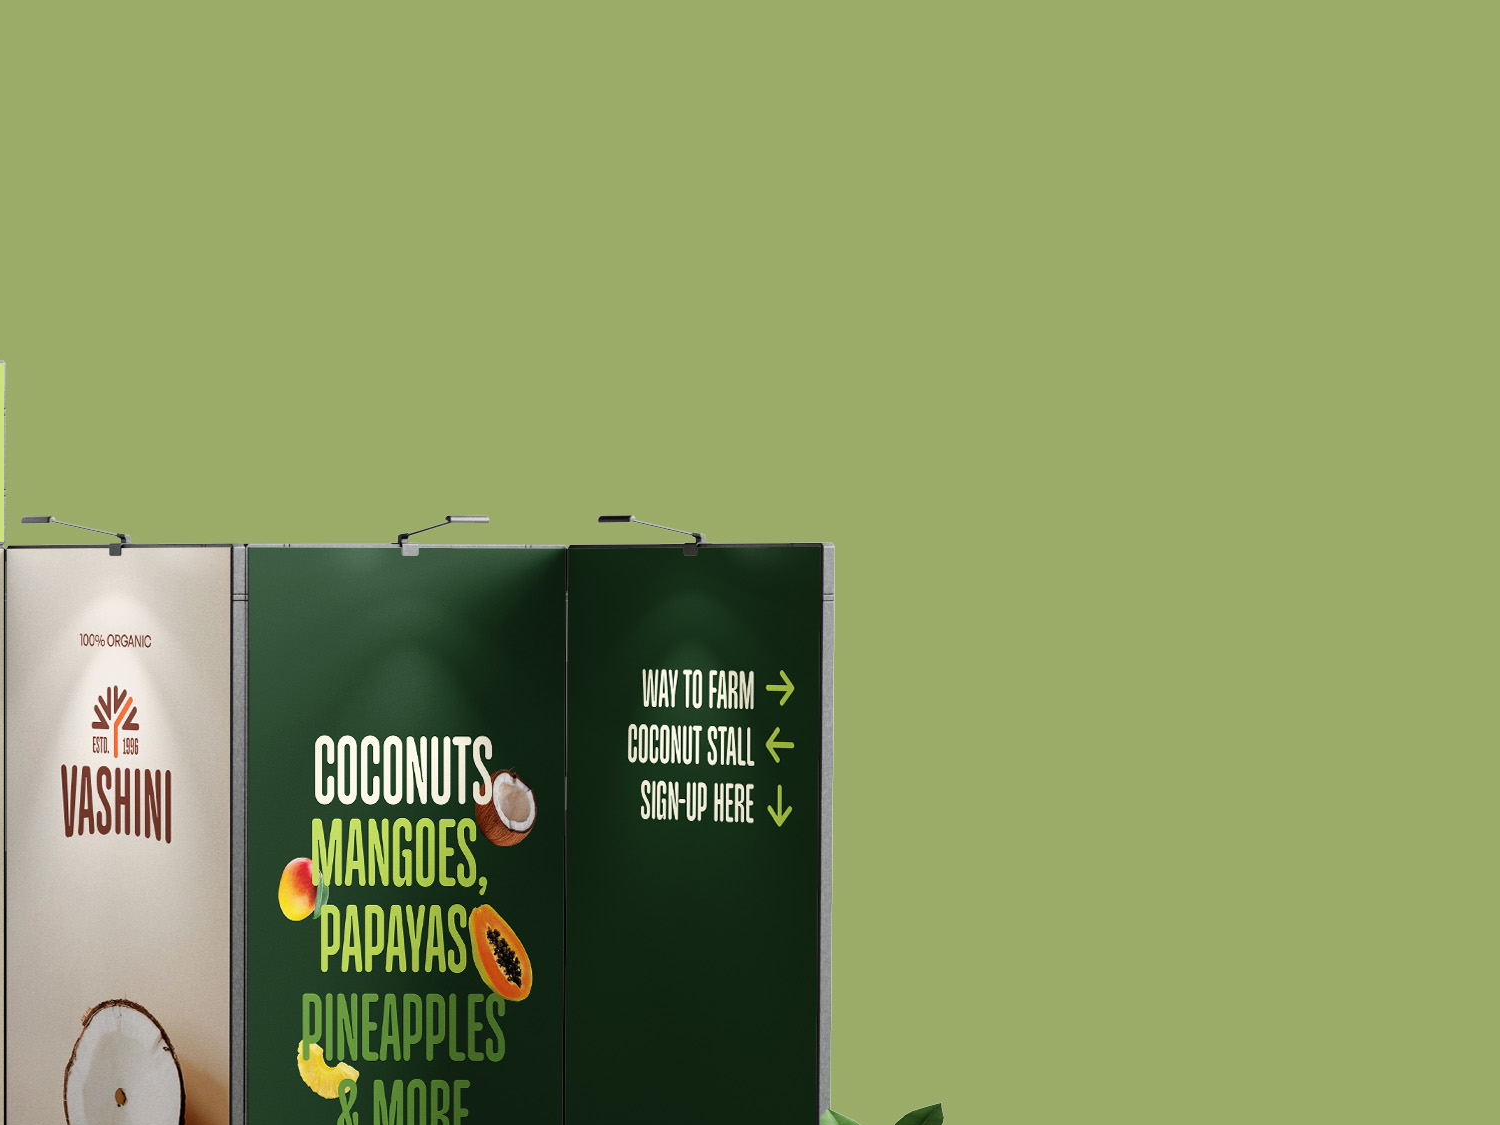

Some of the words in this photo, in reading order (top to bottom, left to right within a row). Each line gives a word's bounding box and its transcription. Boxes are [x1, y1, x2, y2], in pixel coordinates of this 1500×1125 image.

[79, 633, 106, 647] 100%
[107, 634, 152, 648] ORGANIC
[642, 669, 678, 708] WAY
[683, 669, 703, 709] TO
[709, 670, 755, 710] FARM
[92, 736, 110, 754] ESTD.
[122, 738, 139, 755] 1996
[314, 735, 493, 805] COCONUTS
[627, 724, 703, 765] COCONUT
[707, 726, 755, 766] STALL
[61, 764, 171, 844] VASHINI
[640, 780, 708, 821] SIGN-UP
[714, 783, 755, 823] HERE
[311, 818, 488, 896] MANGOES,
[320, 904, 467, 974] PAPAYAS
[302, 993, 506, 1062] PINEAPPLES
